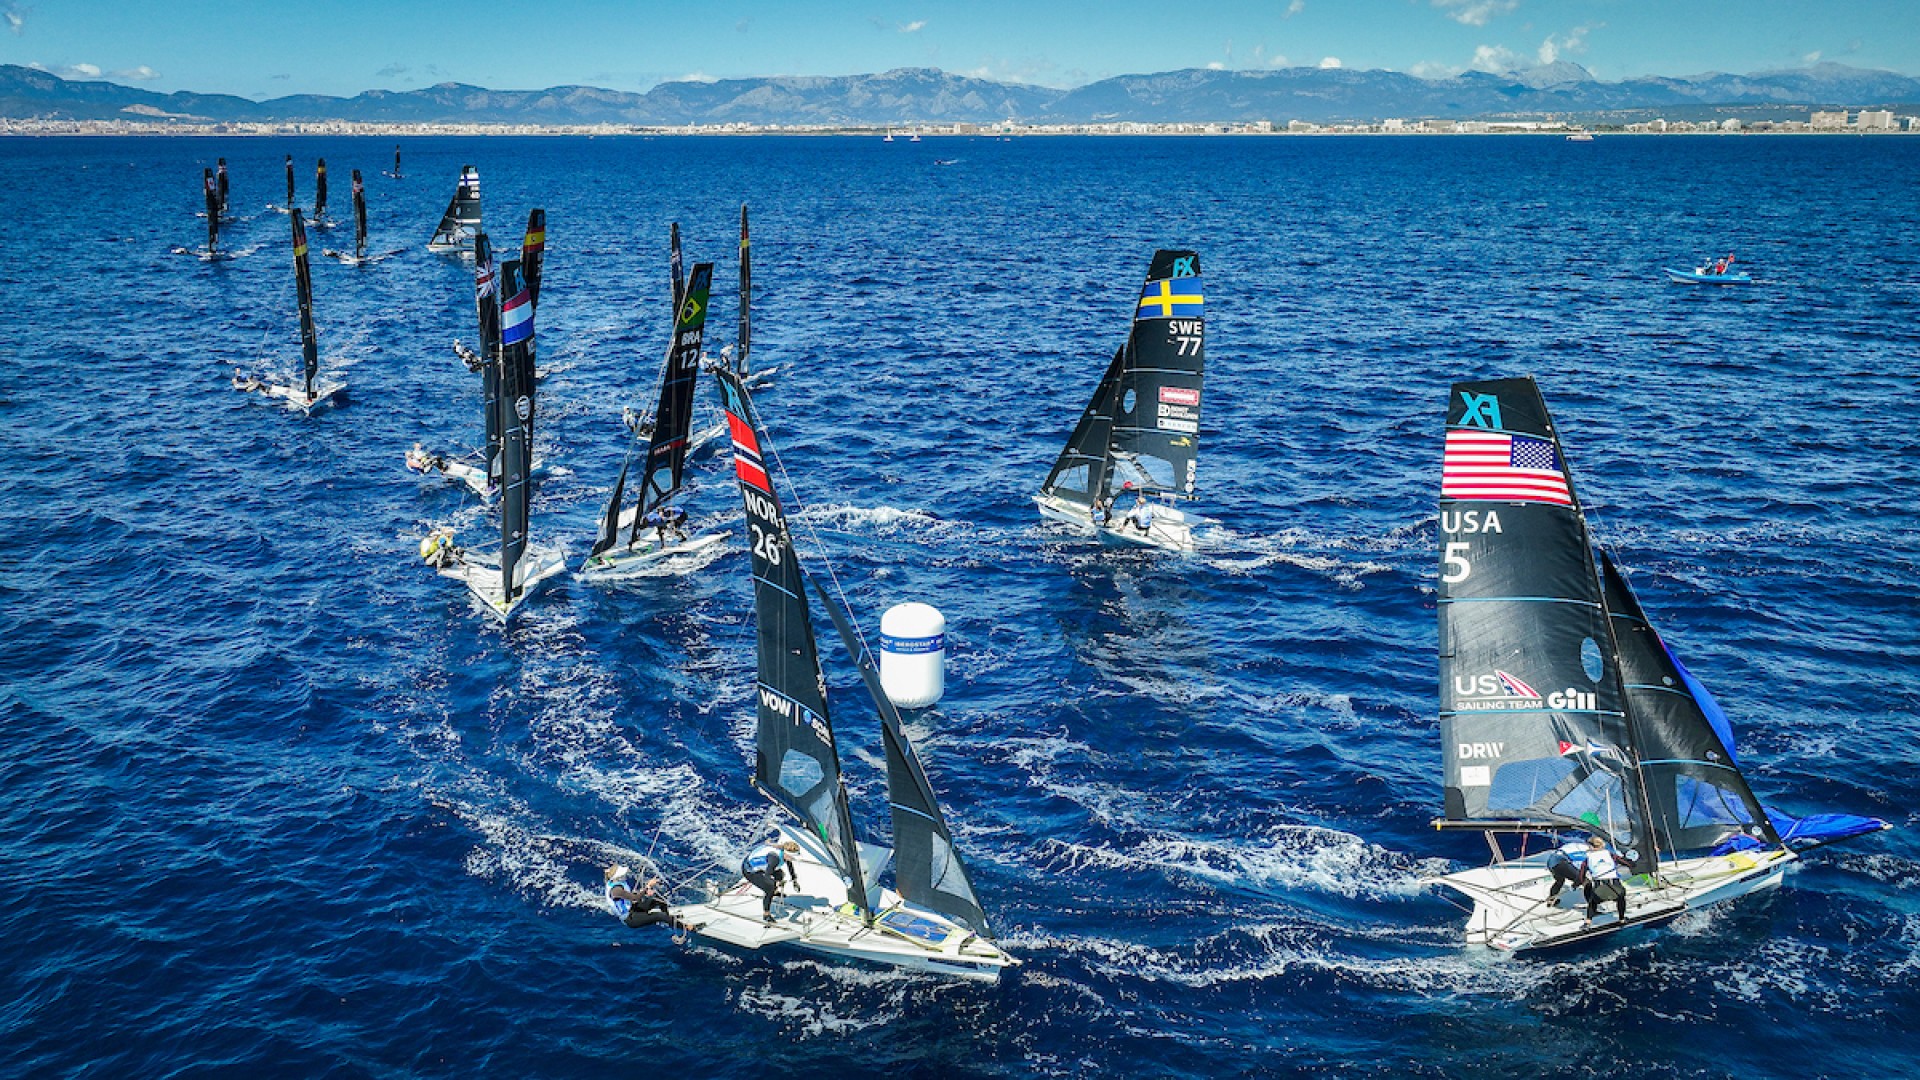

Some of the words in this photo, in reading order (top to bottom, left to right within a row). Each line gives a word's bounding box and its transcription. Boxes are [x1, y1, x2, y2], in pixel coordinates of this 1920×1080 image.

[1172, 255, 1196, 278] FX
[681, 330, 700, 347] BRA
[1169, 320, 1202, 335] SWE
[1176, 336, 1202, 356] 77
[680, 349, 699, 370] 12
[744, 489, 780, 529] NOR
[1441, 510, 1503, 535] USA
[750, 522, 781, 567] 26
[1441, 541, 1472, 583] 5
[1455, 674, 1498, 696] US
[760, 688, 792, 718] VOW
[1456, 701, 1505, 711] SAILING
[1508, 700, 1543, 710] TEAM
[1548, 687, 1597, 710] Gill
